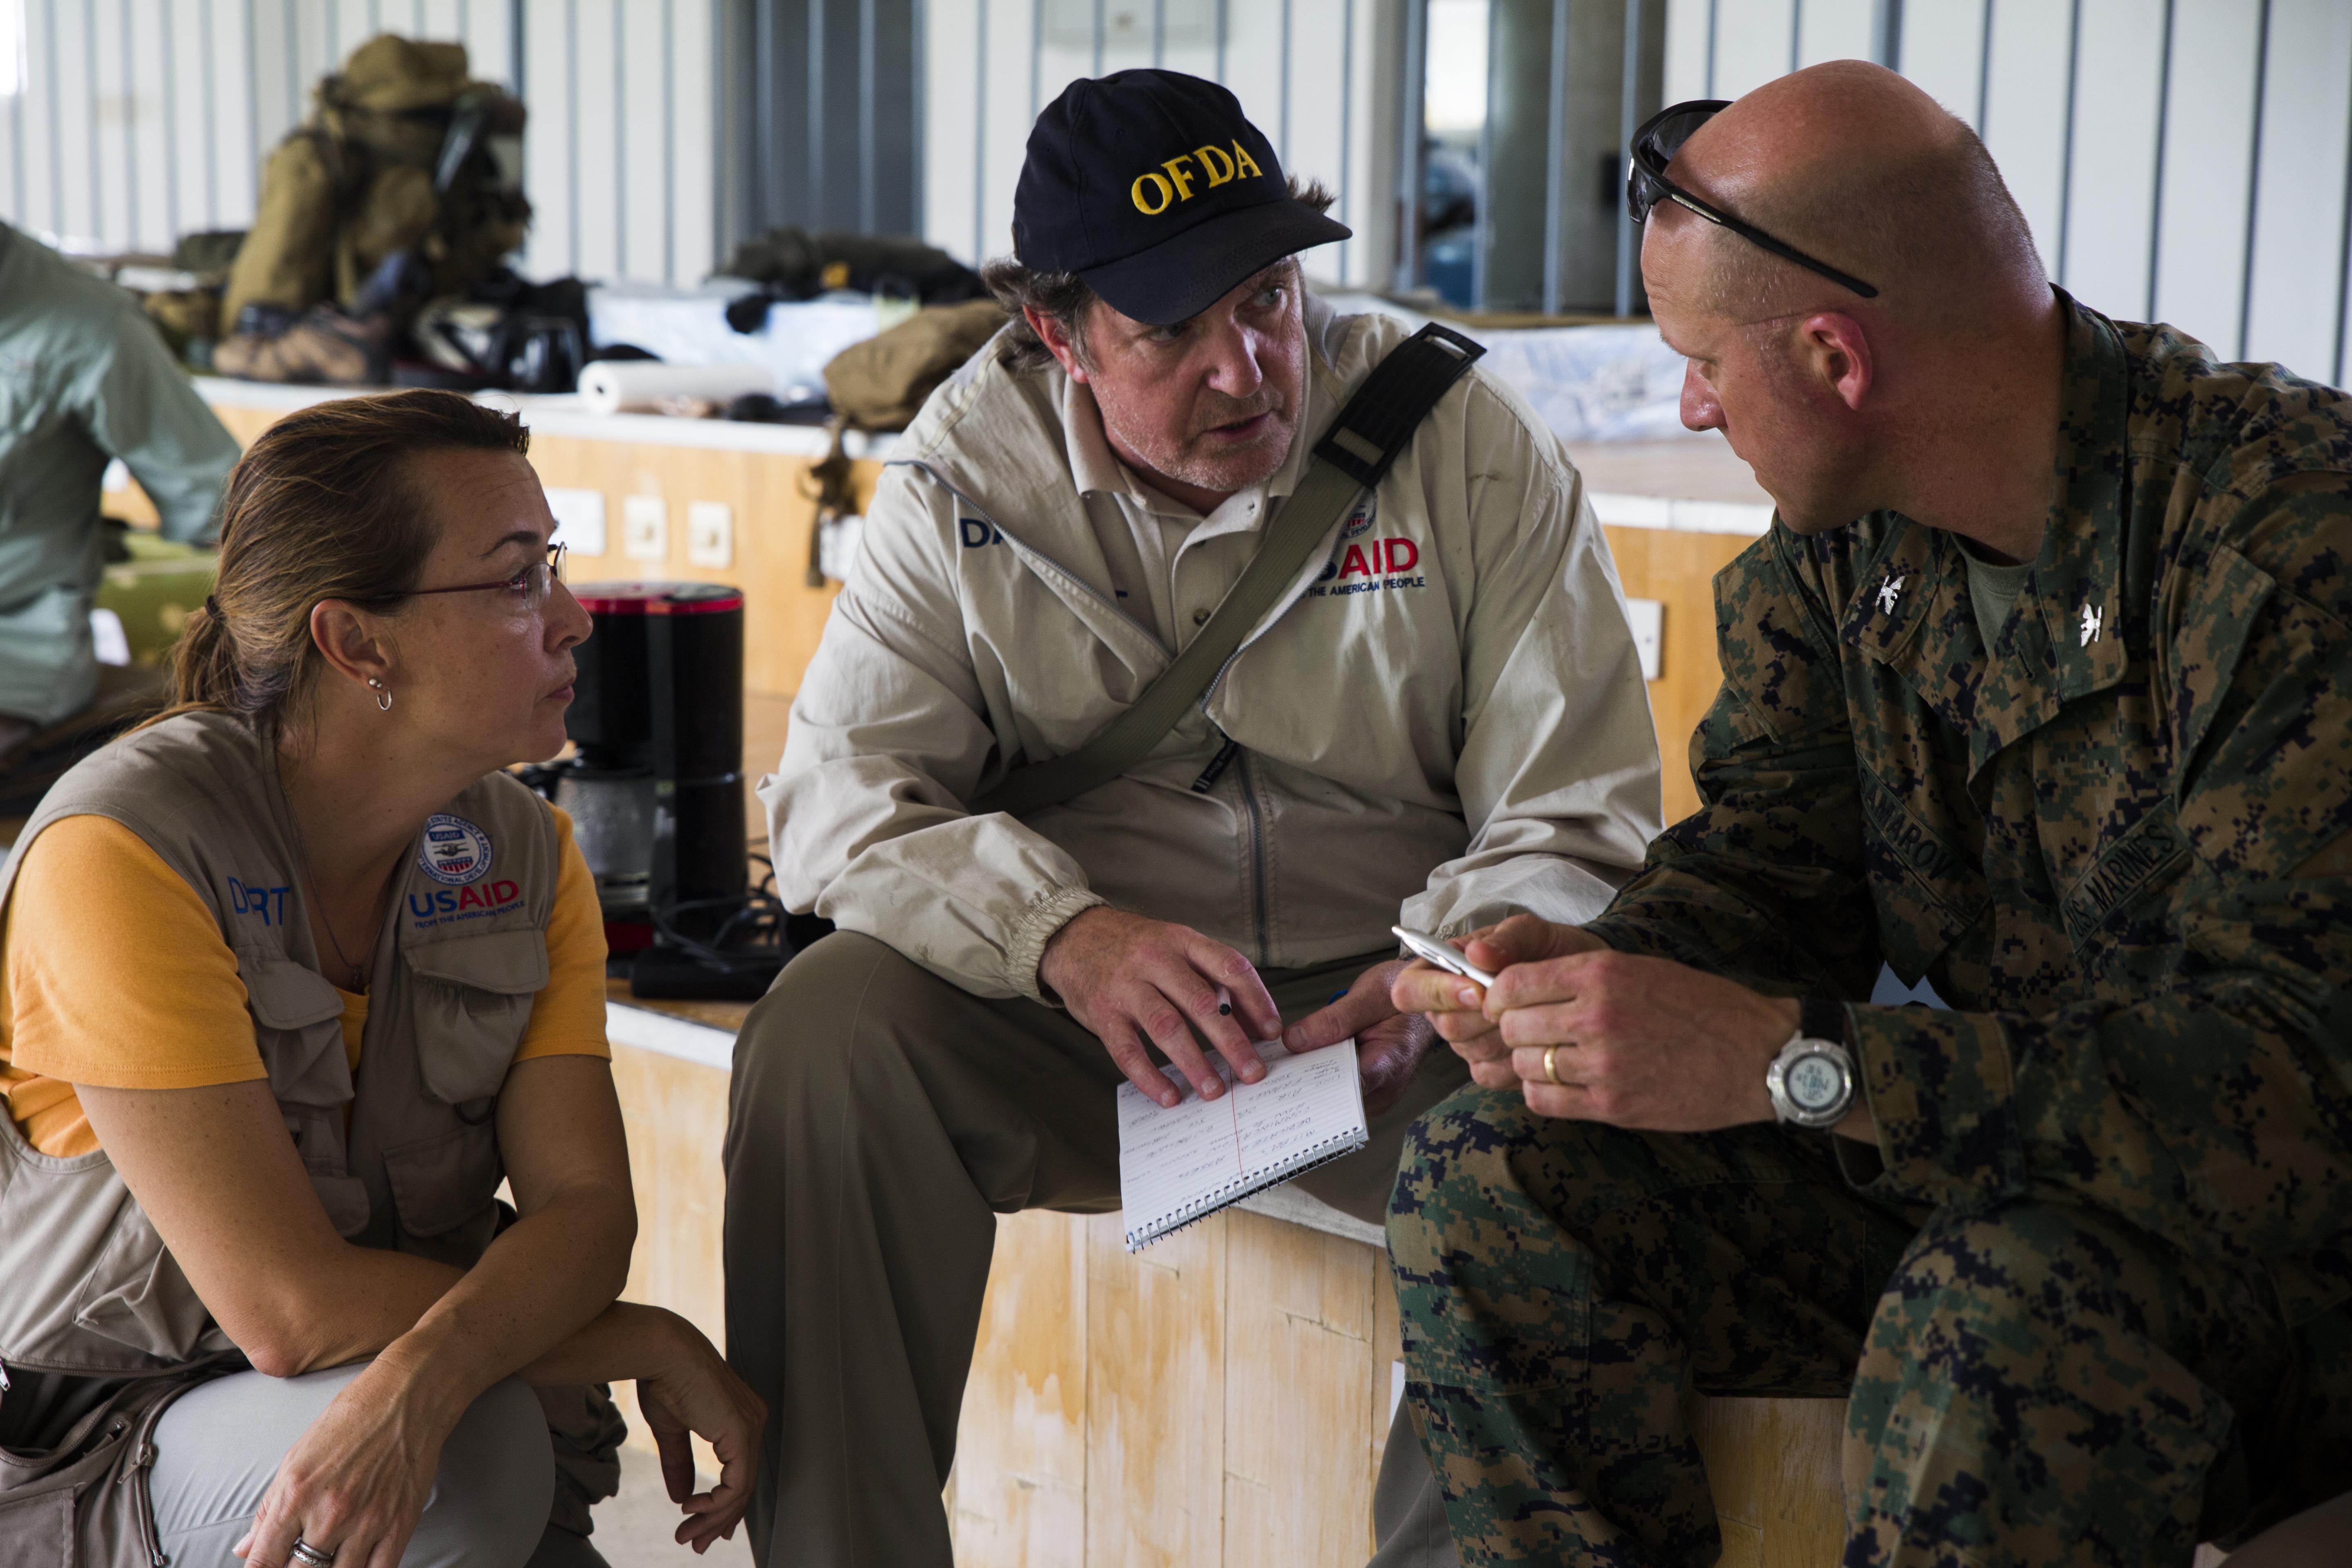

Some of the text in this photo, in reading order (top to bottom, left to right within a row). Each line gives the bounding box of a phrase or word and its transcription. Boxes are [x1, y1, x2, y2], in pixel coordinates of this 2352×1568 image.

[1131, 139, 1263, 215] OFDA
[1309, 577, 1425, 597] THE AMERICAN PEOPLE
[2085, 824, 2175, 913] MARINES
[409, 880, 519, 917] USAID
[415, 900, 526, 929] FROM THE AMERICAN PEOPLE
